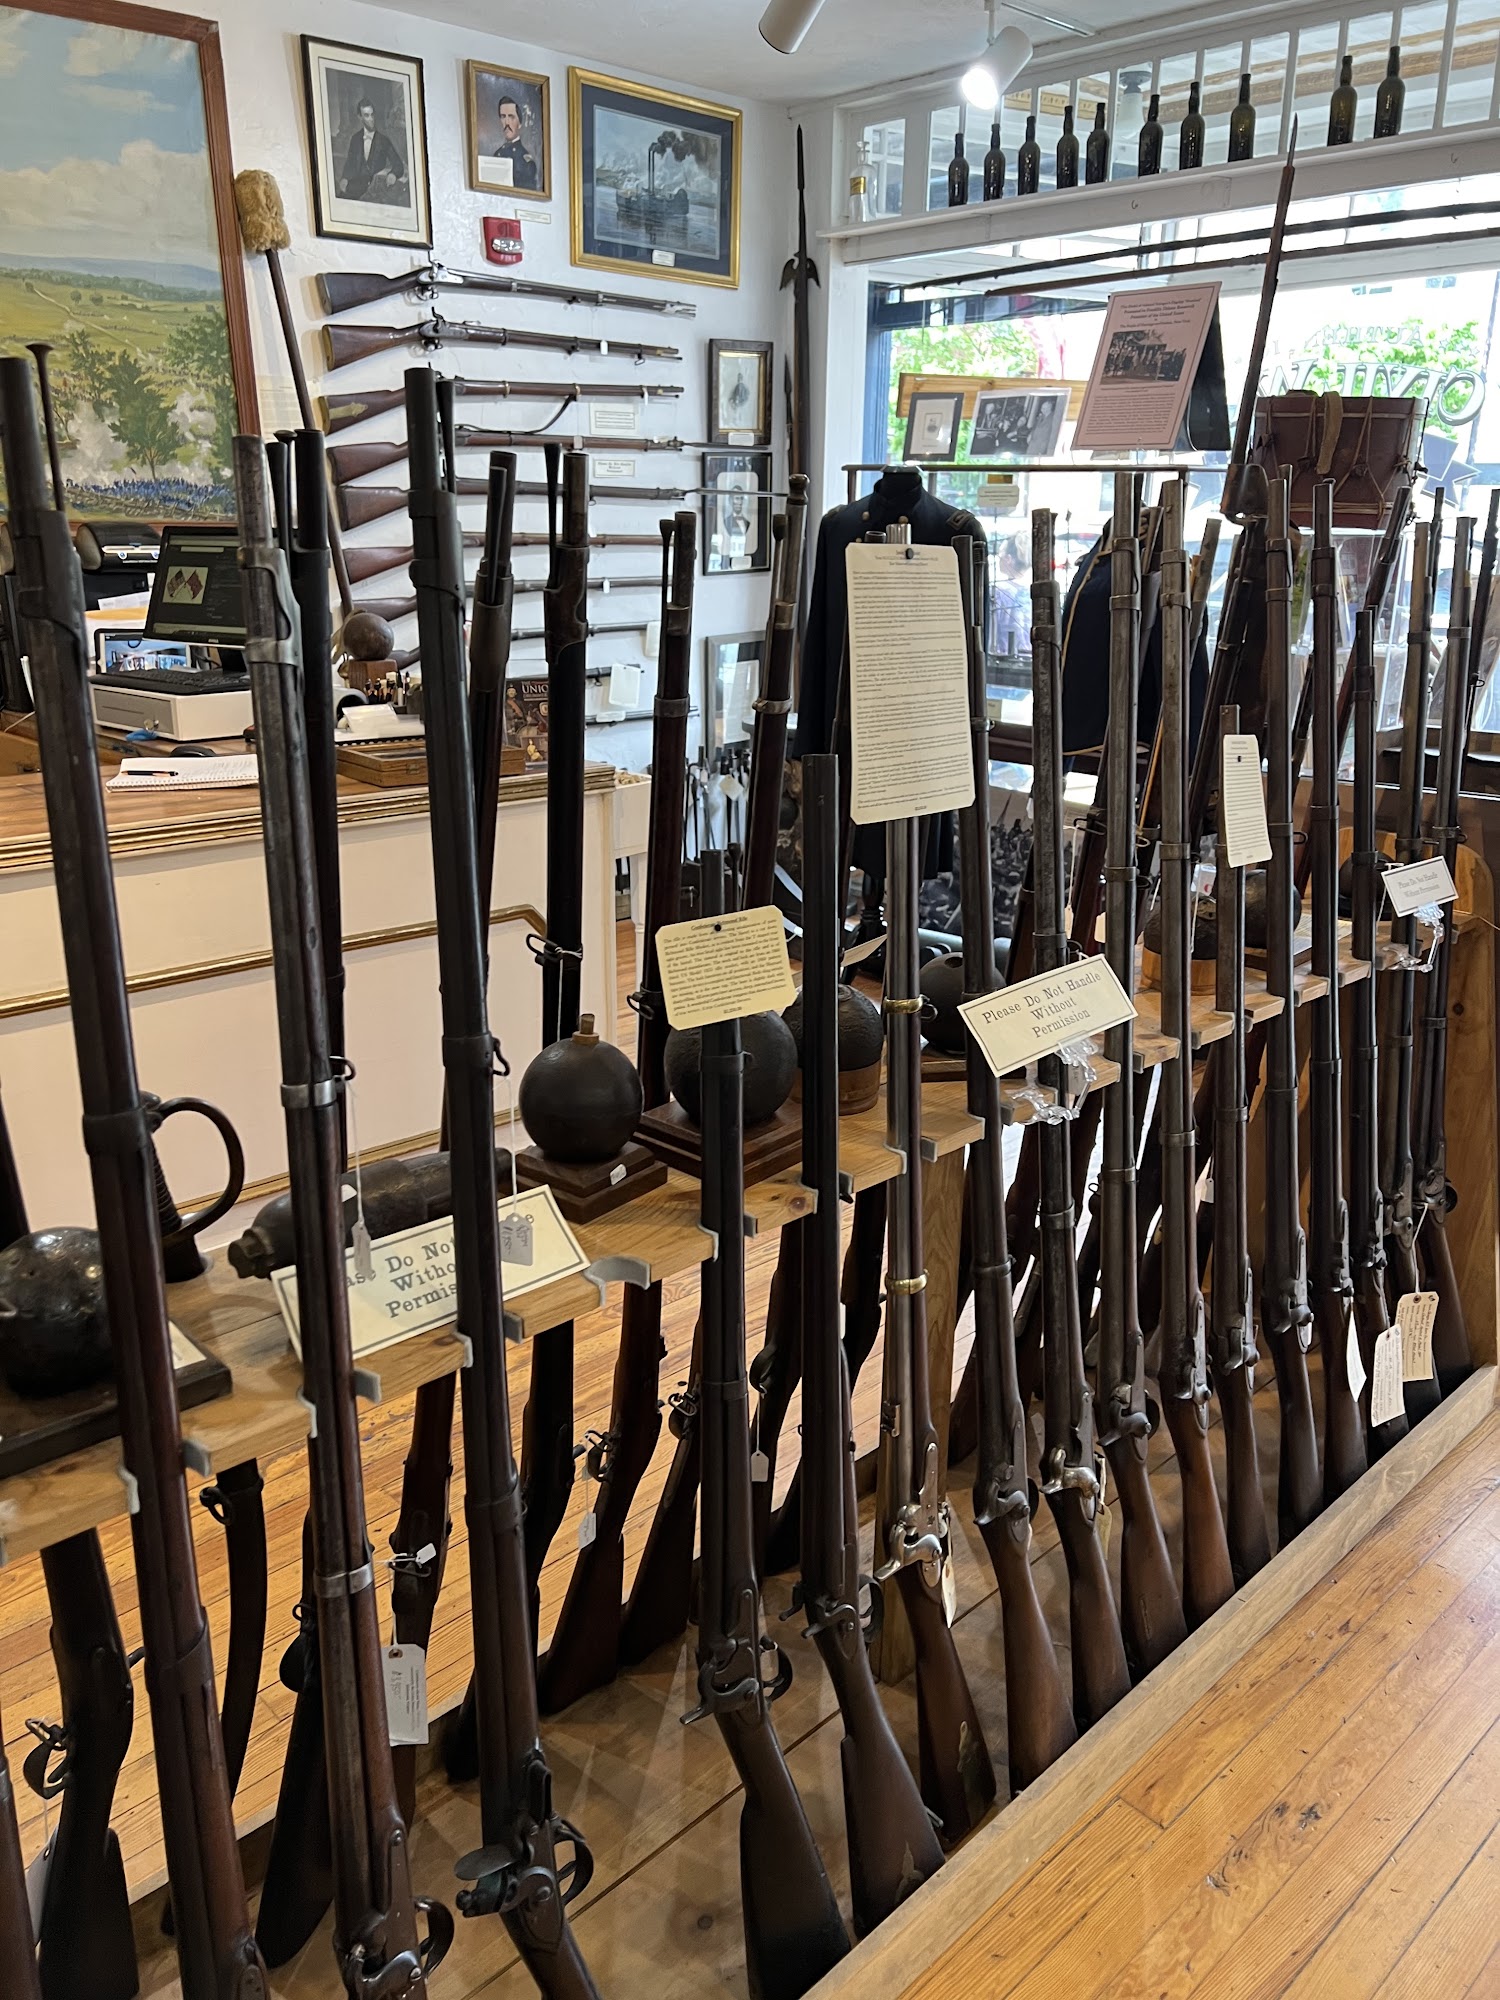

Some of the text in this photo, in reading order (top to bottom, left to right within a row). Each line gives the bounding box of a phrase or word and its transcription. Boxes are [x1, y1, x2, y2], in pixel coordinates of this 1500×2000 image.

[522, 684, 549, 694] UNIO
[982, 971, 1101, 1025] Please Do Not Handle
[1030, 996, 1077, 1022] Without
[1032, 1007, 1091, 1038] Permission
[385, 1255, 414, 1273] Do
[421, 1236, 455, 1260] No
[390, 1262, 456, 1292] Witho
[385, 1282, 457, 1318] Permis
